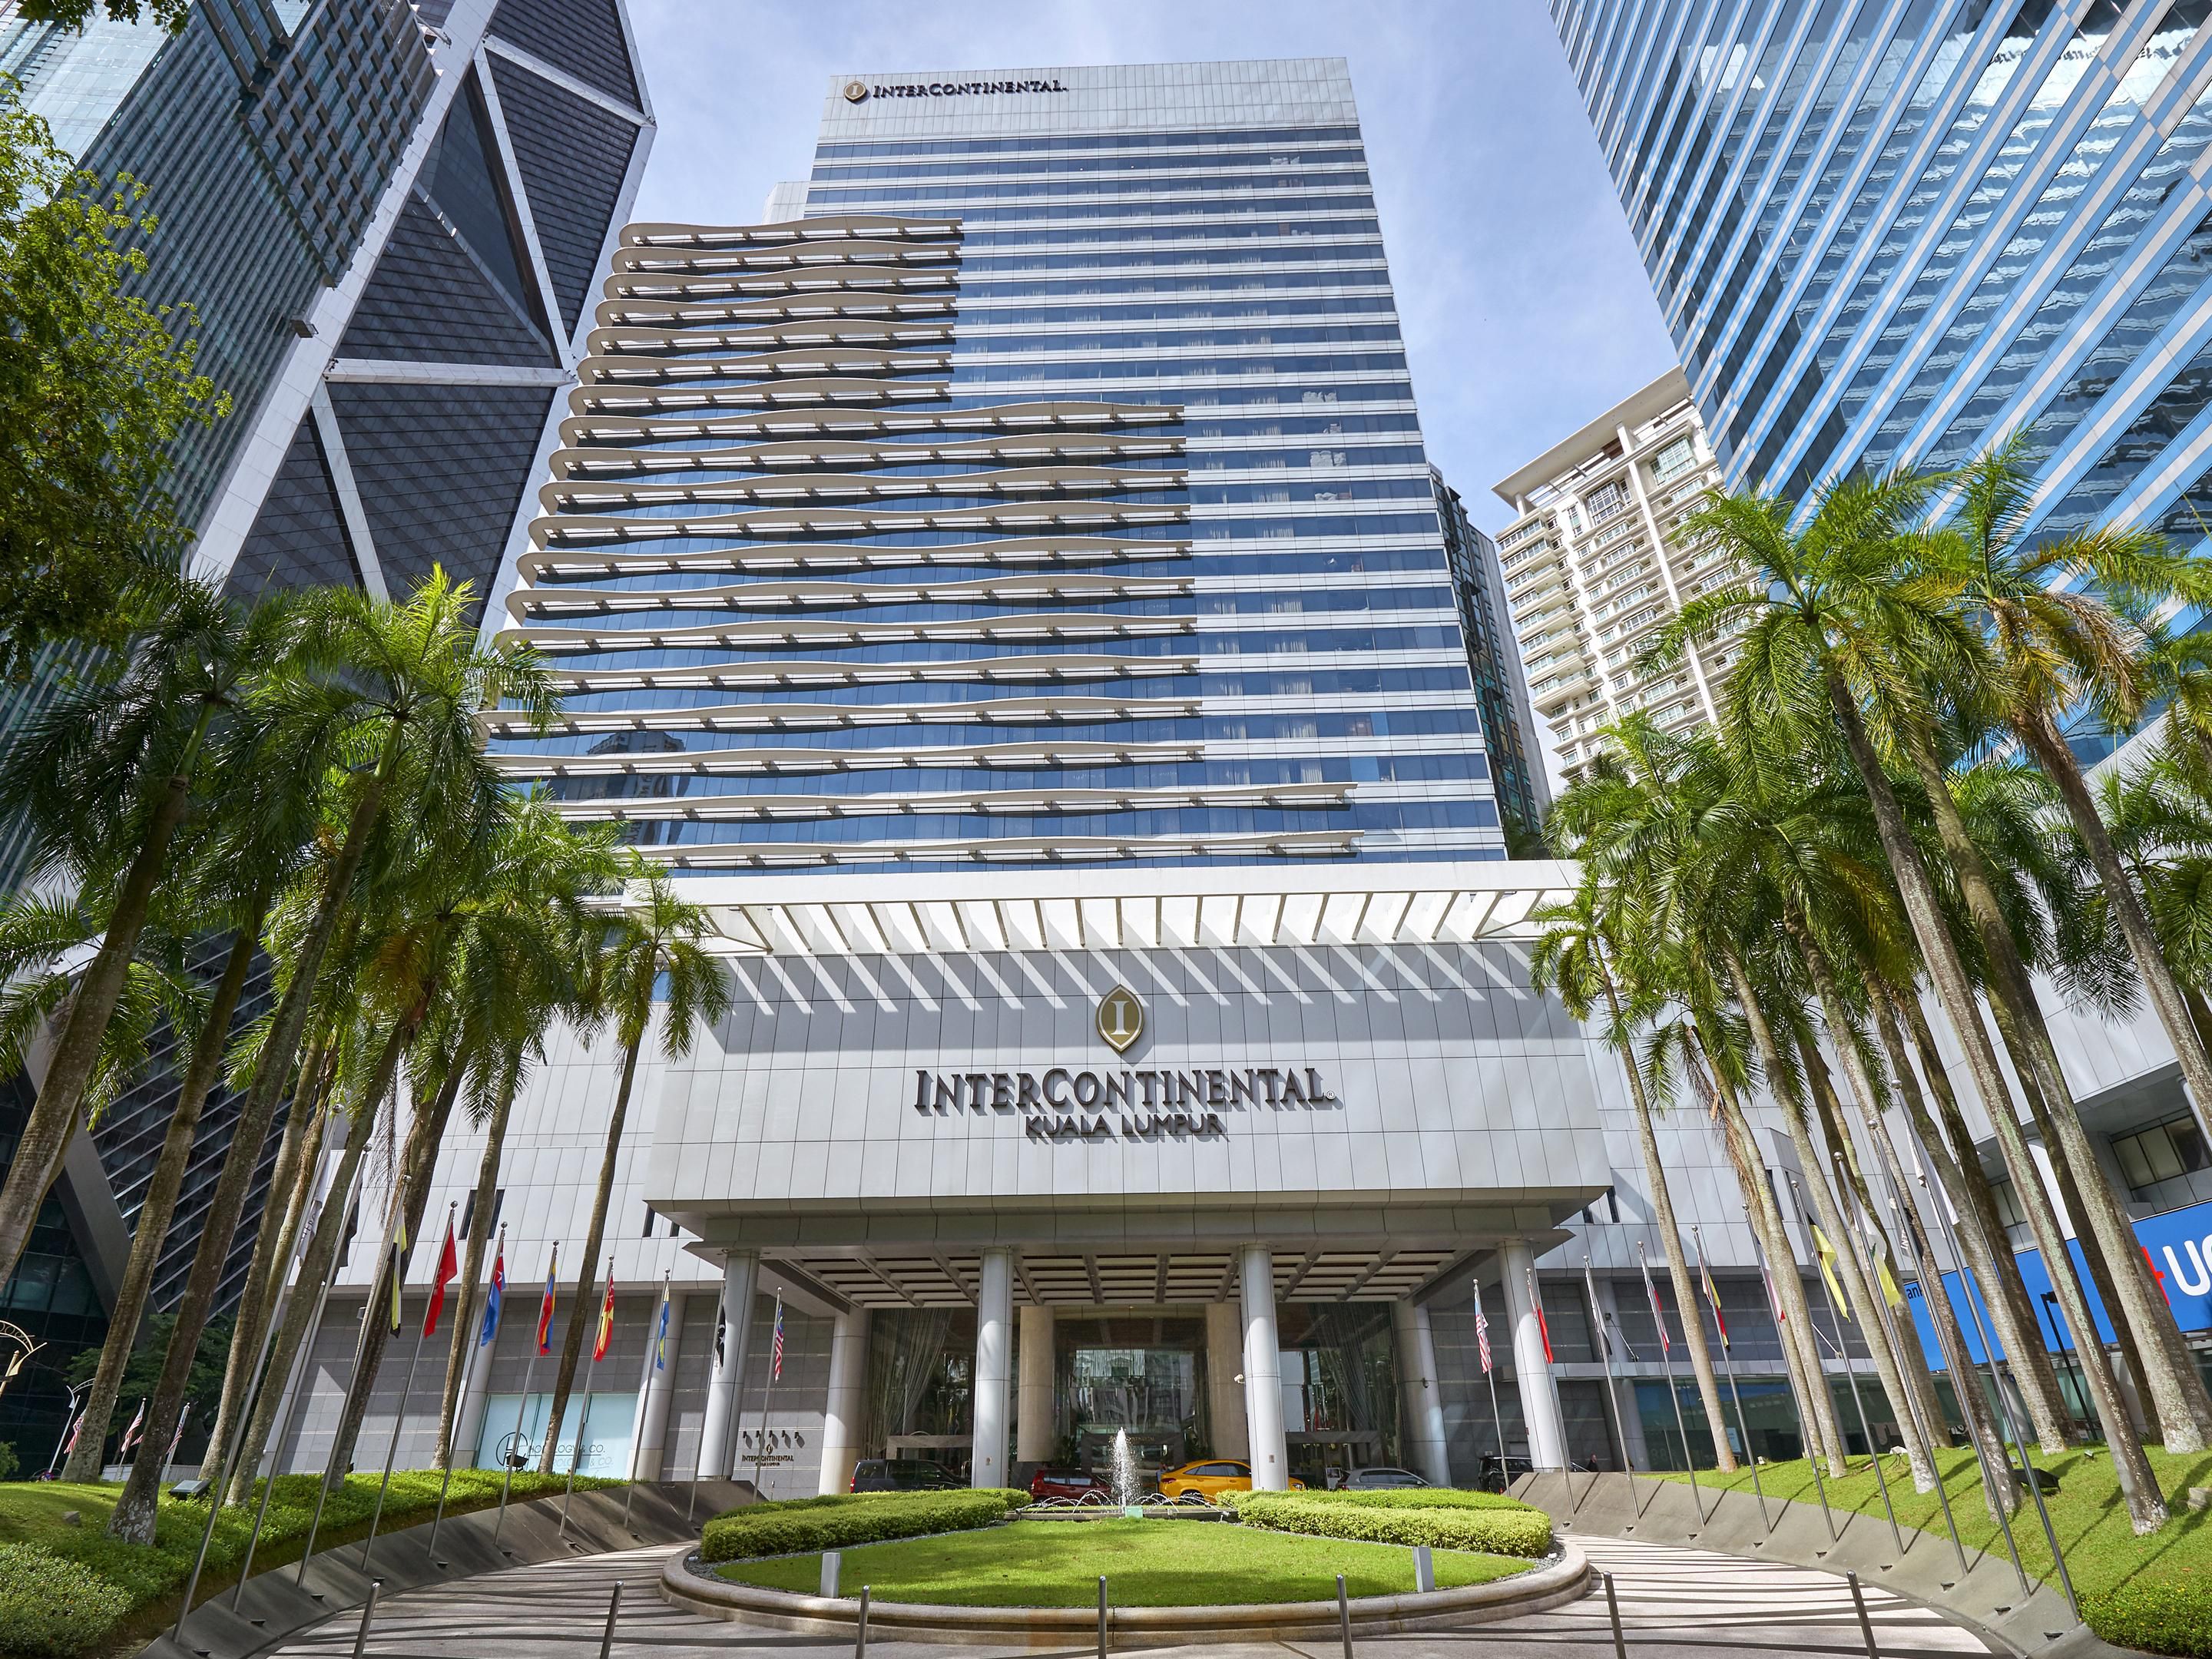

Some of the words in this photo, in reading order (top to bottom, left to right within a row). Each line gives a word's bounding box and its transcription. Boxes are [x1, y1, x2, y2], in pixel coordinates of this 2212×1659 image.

[873, 80, 1062, 98] INTERCONTINENTAL
[1111, 1001, 1131, 1035] I
[914, 1068, 1324, 1108] INTERCONTINENTAL
[1025, 1114, 1111, 1136] KUALA
[1121, 1114, 1223, 1134] LUMPUR
